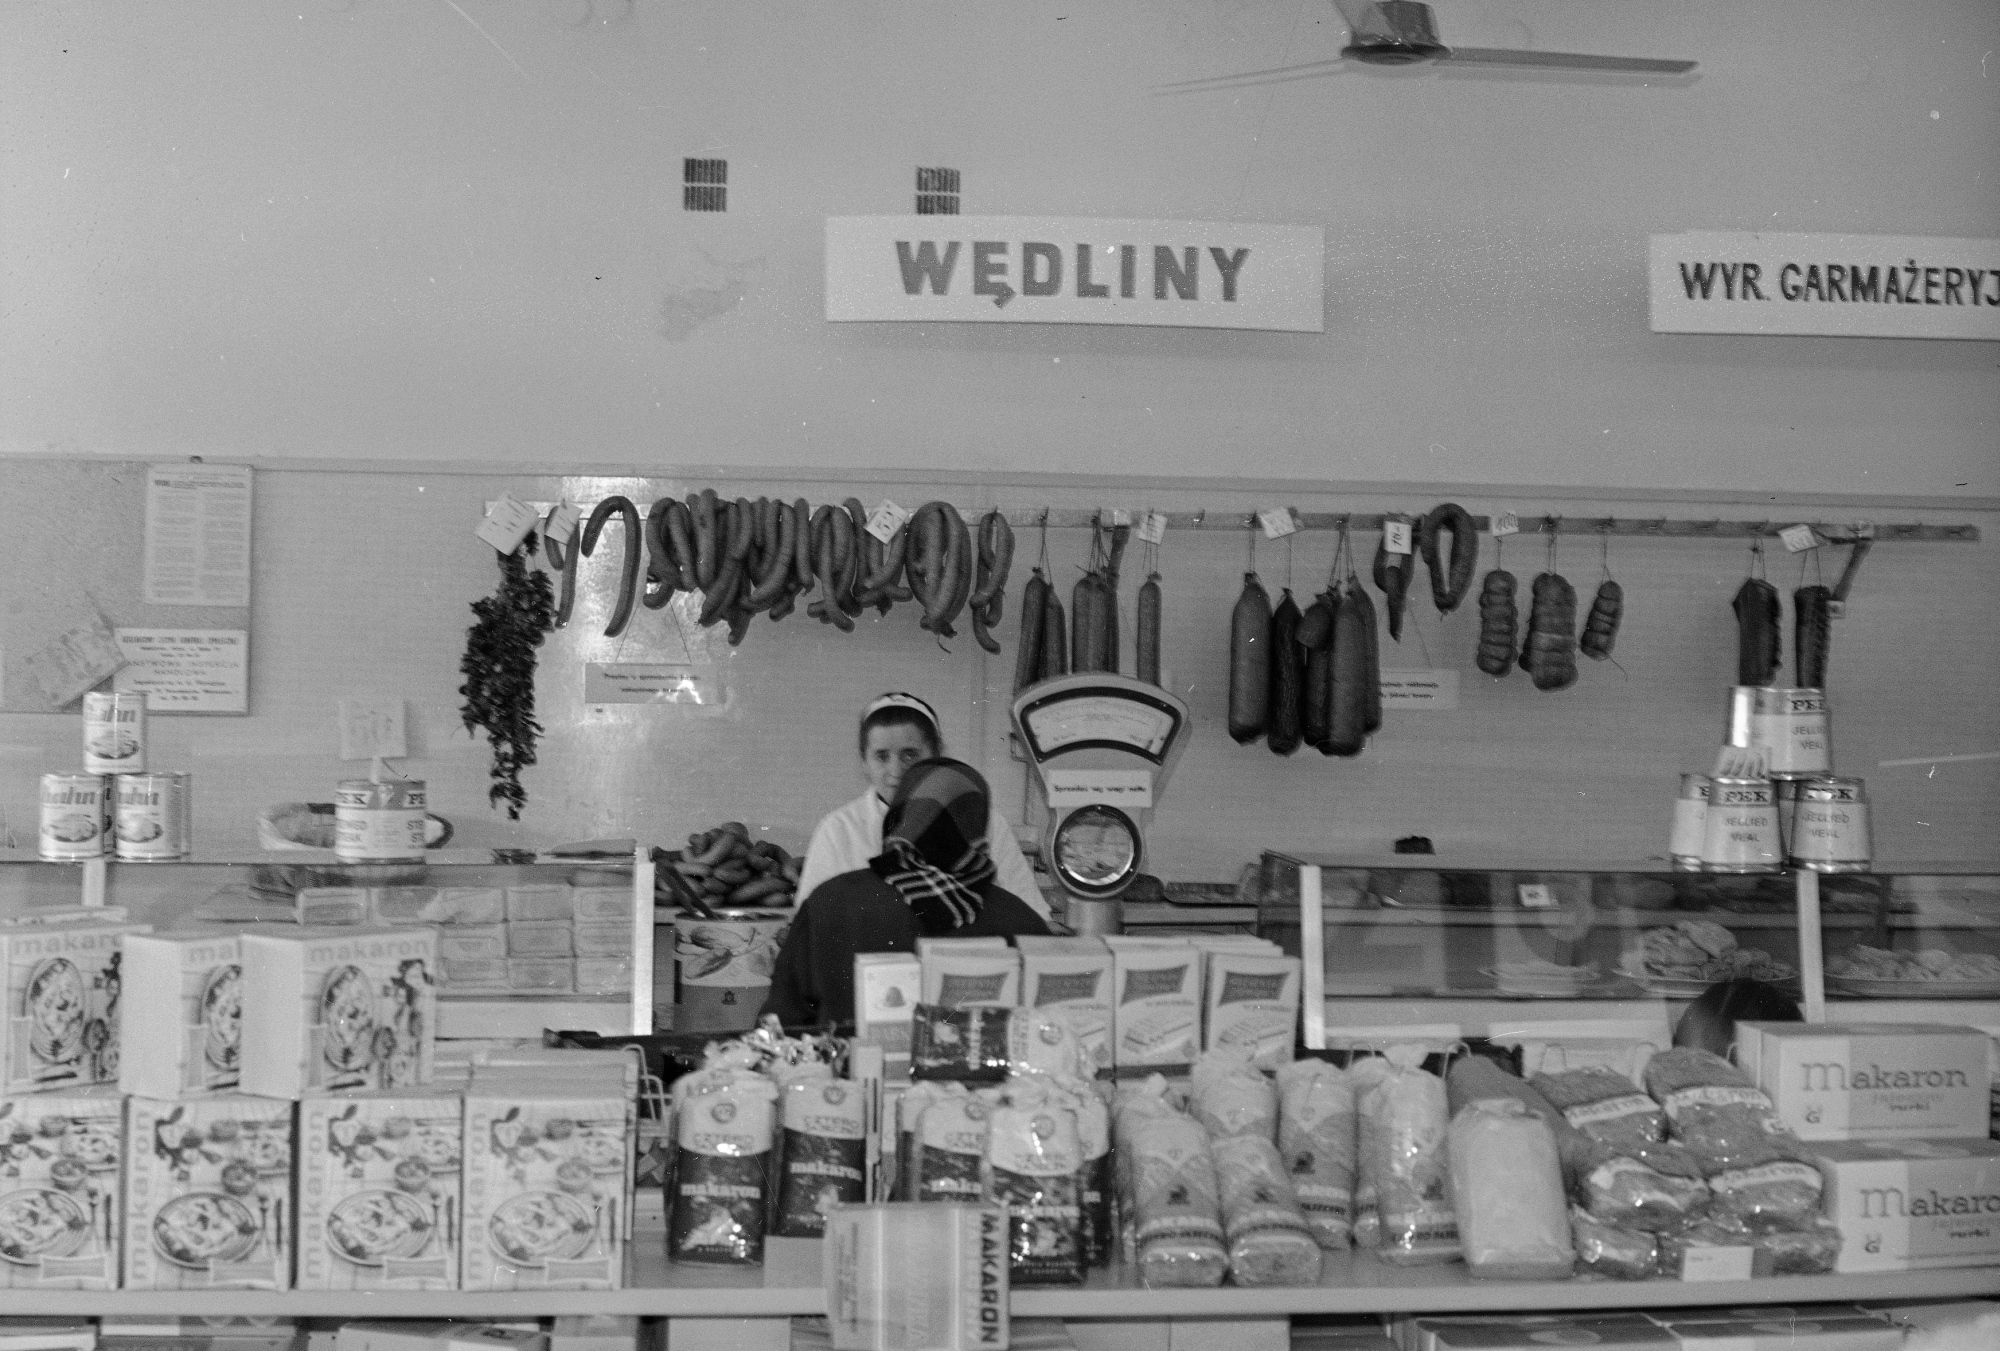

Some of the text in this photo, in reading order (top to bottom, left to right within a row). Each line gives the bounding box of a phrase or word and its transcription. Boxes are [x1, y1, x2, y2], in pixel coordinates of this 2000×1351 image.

[895, 240, 1251, 309] WĘDLINY
[1679, 261, 1771, 301] WYR.
[1725, 790, 1769, 802] PEK
[310, 939, 429, 962] makaron
[130, 1112, 149, 1280] makaron
[303, 1111, 322, 1280] makaron
[466, 1112, 486, 1281] makaron
[681, 1179, 760, 1199] makaron
[981, 1213, 999, 1343] MAKARON
